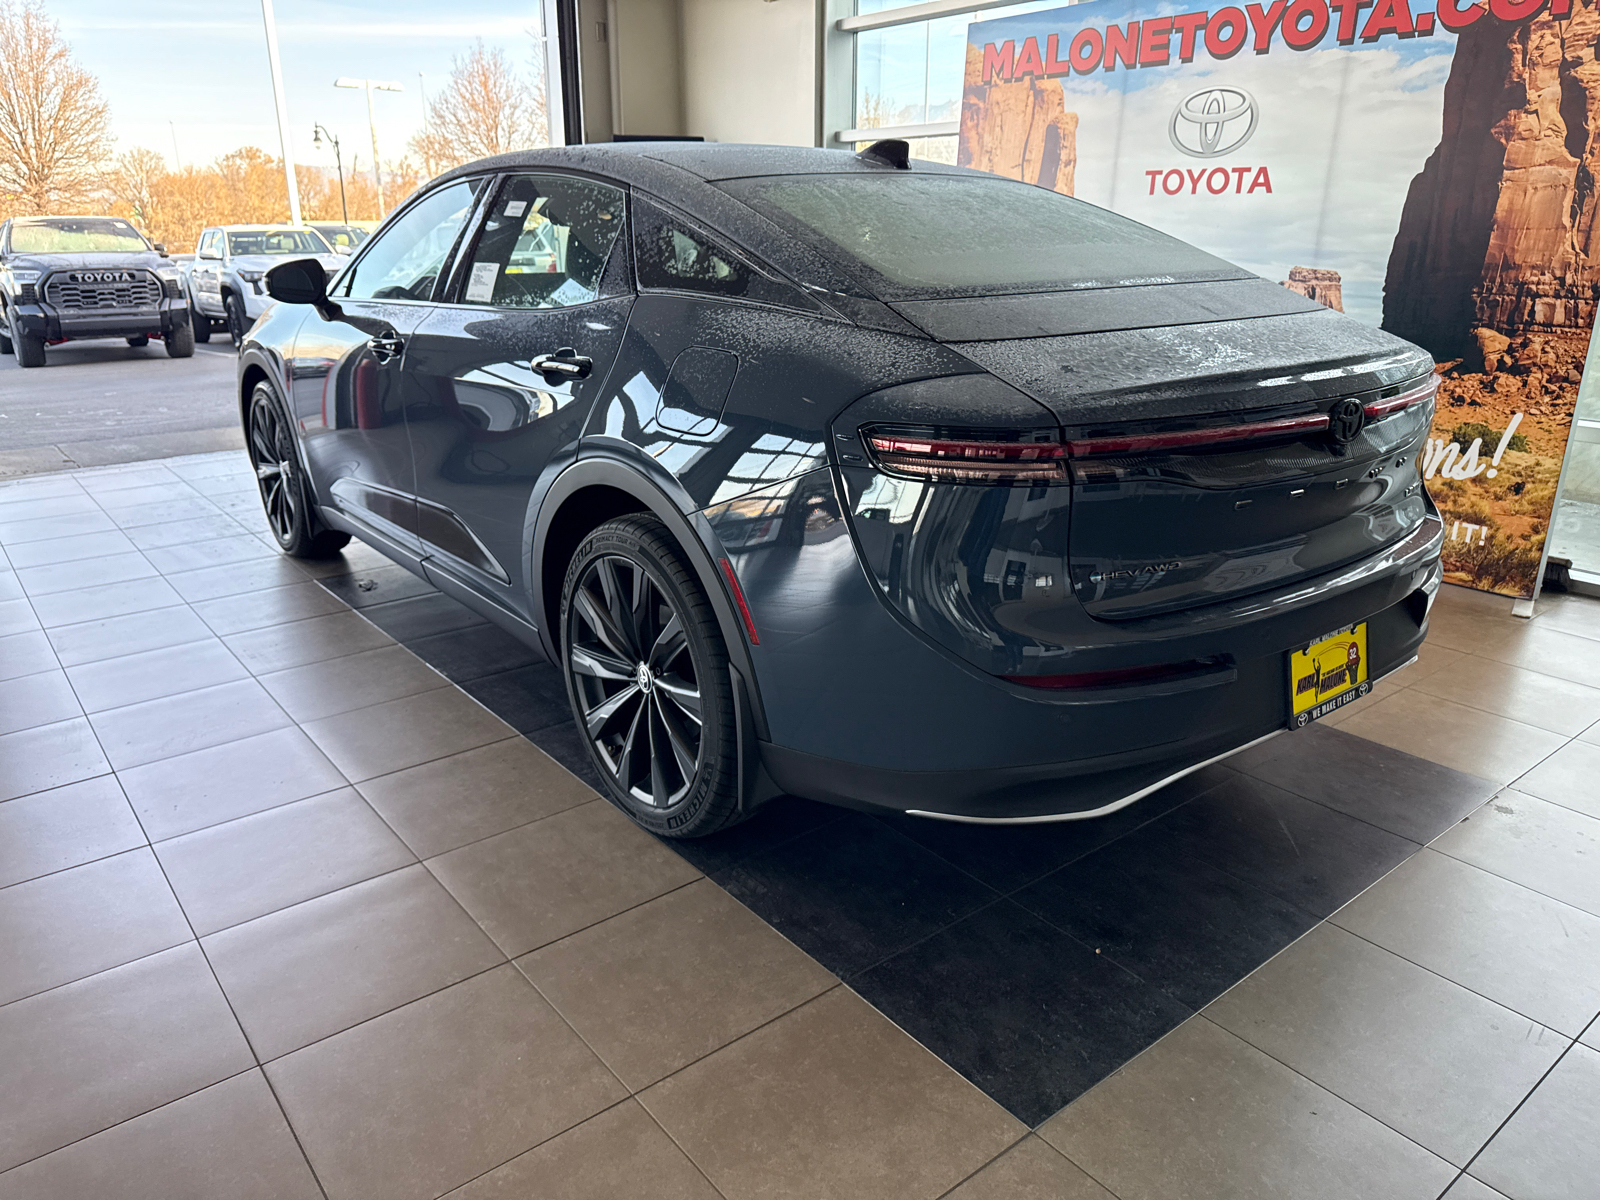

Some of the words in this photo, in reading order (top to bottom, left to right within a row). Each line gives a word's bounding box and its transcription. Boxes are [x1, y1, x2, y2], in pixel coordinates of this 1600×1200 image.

[982, 0, 1600, 84] MALONETOYOTA.C
[1145, 166, 1273, 196] TOYOTA
[75, 272, 131, 282] TOYOTA
[1451, 521, 1488, 546] IT!
[1349, 647, 1357, 660] 32
[1312, 708, 1321, 719] WE
[1322, 700, 1336, 714] MAKE
[1337, 697, 1342, 707] IT
[1343, 690, 1355, 704] EASY
